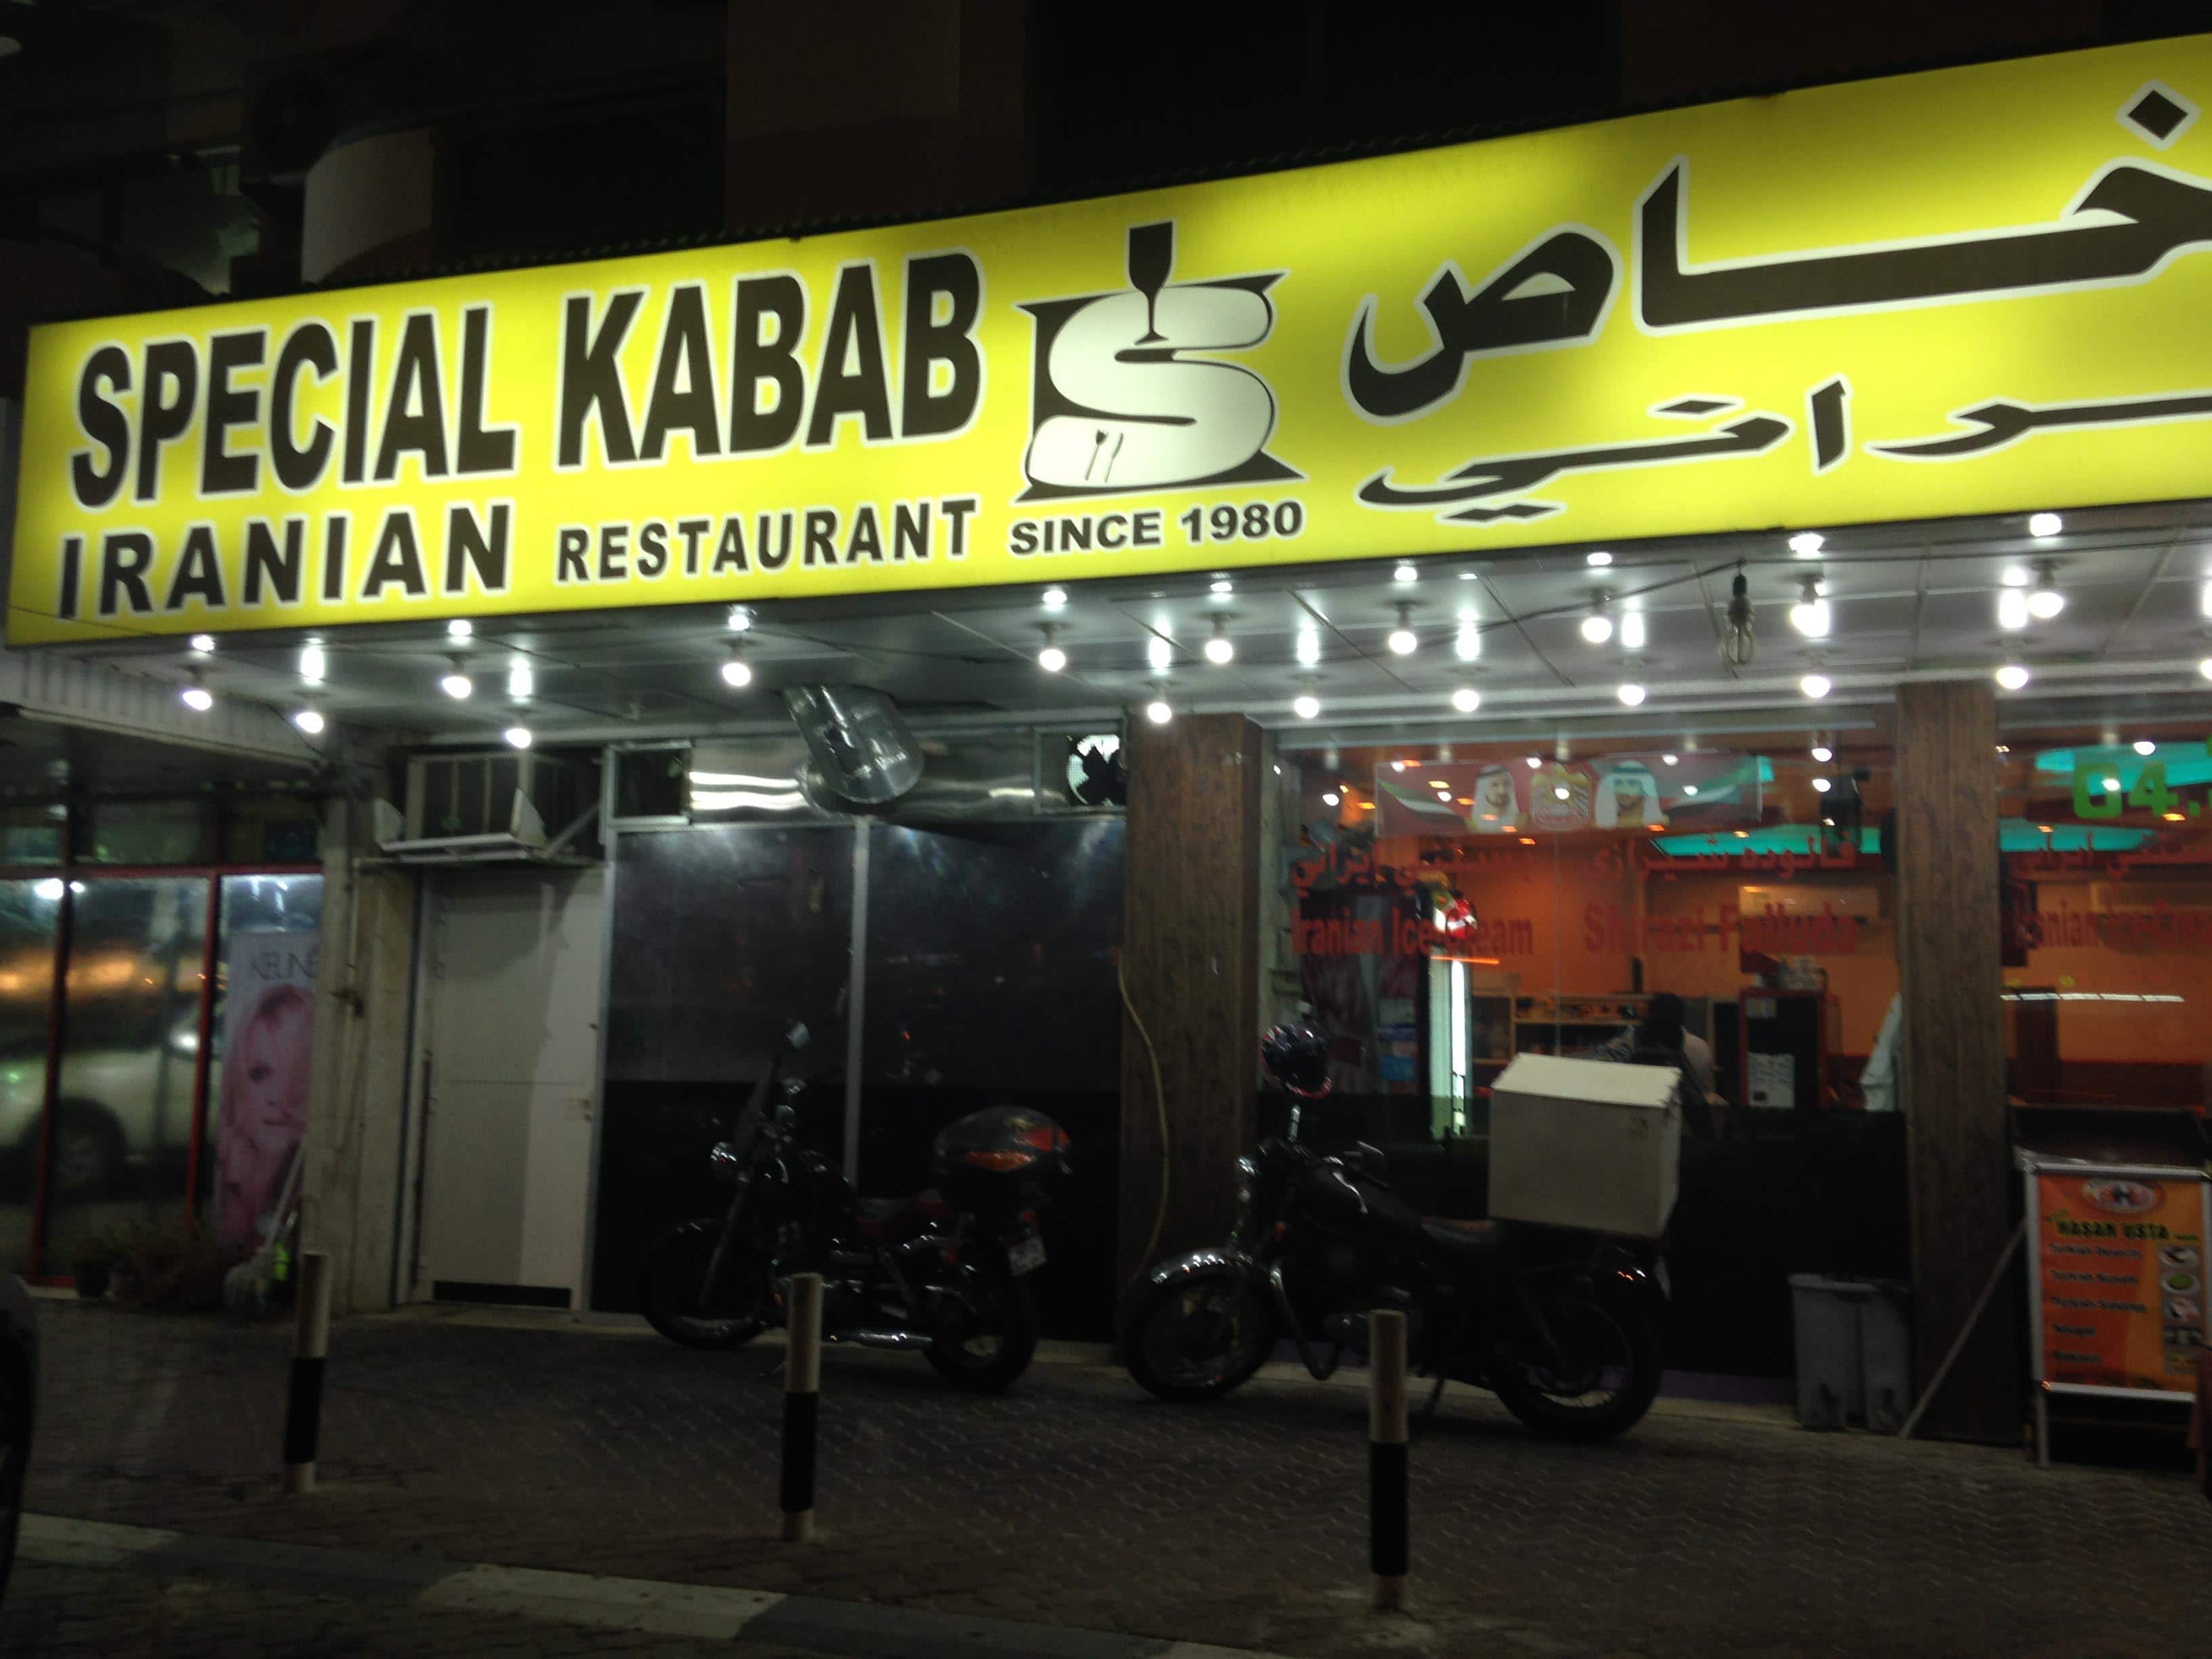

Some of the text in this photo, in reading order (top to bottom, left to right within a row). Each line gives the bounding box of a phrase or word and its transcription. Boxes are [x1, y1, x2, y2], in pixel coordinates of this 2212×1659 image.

[71, 252, 981, 508] SPECIAL KABAB
[1010, 500, 1303, 556] SINCE 1980
[58, 498, 976, 620] IRANIAN RESTAURANT
[2072, 762, 2212, 820] 04.
[1292, 905, 1384, 955] Iranian
